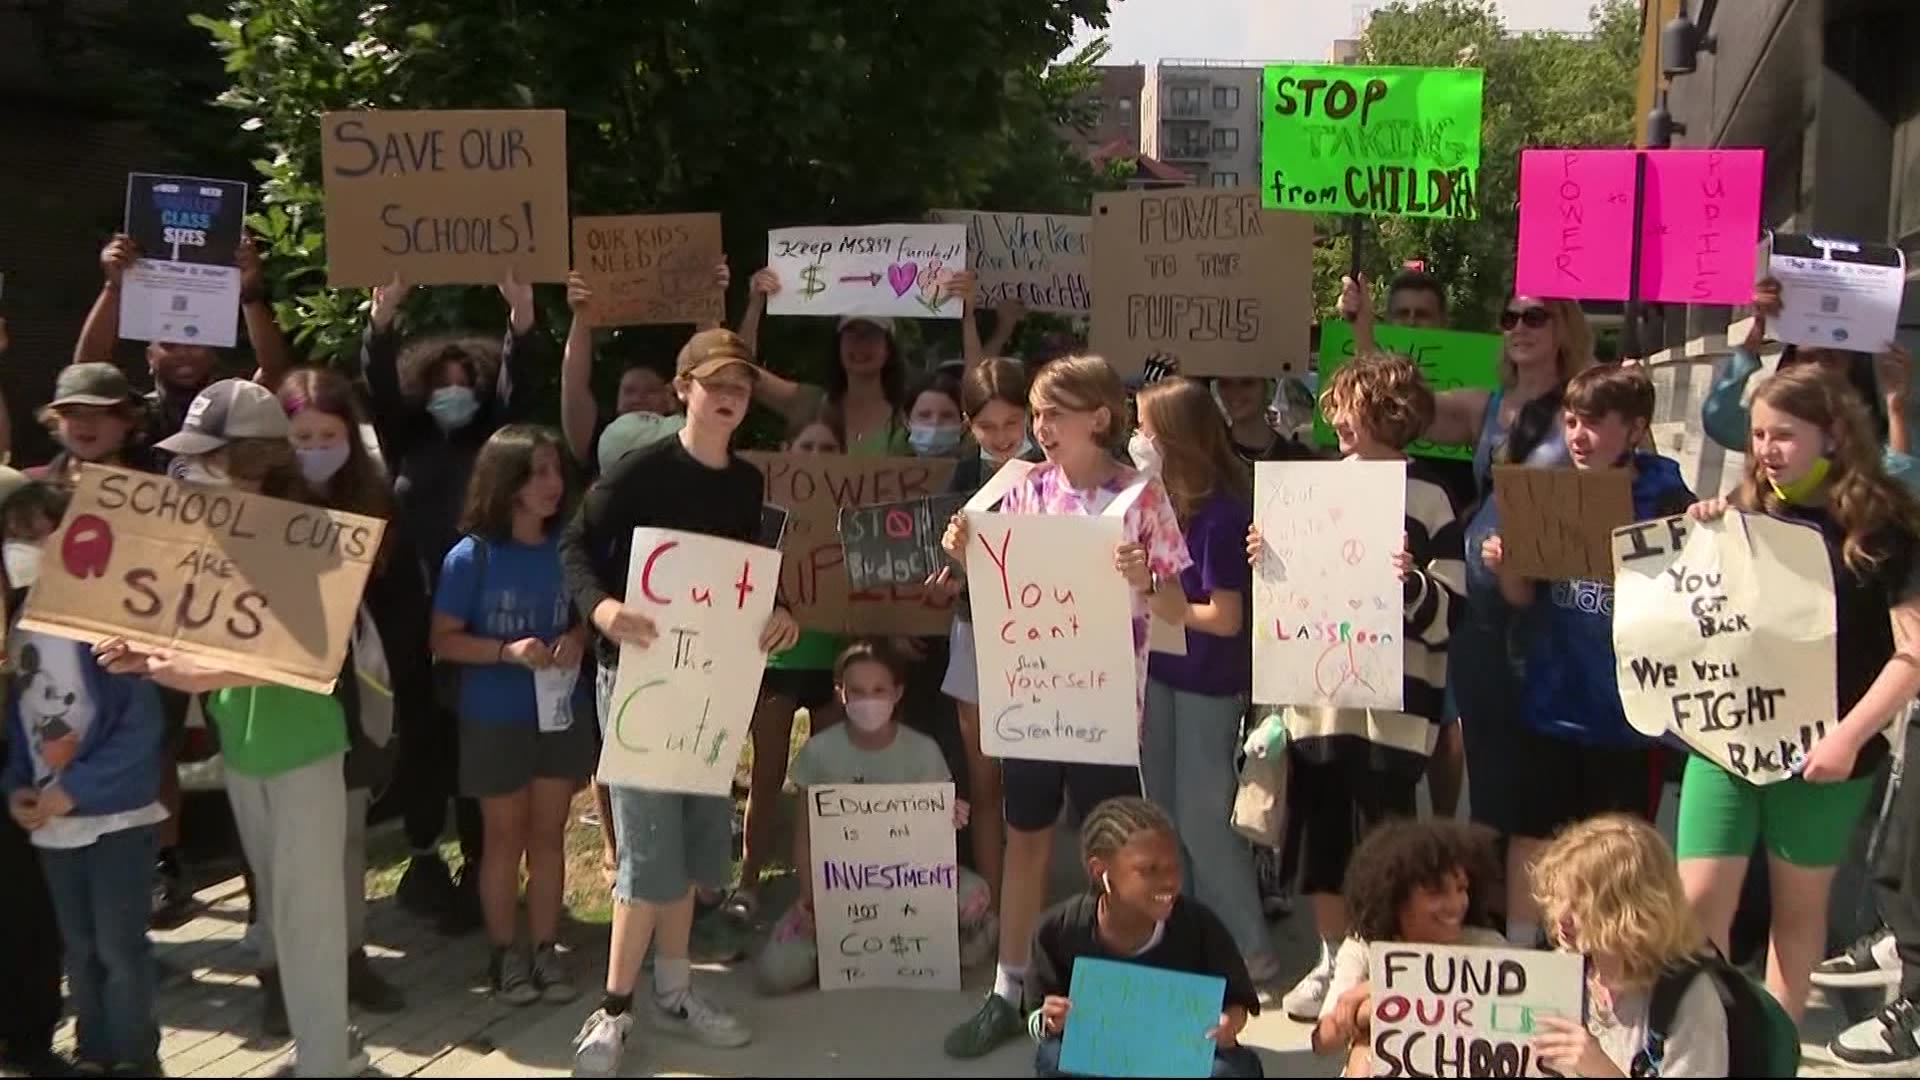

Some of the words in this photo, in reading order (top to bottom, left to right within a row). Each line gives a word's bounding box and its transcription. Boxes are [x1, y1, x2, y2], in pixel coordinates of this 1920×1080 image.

[1275, 76, 1388, 127] STOP
[334, 120, 446, 178] SAVE
[460, 128, 533, 171] OUR
[1303, 116, 1467, 167] TAKING
[1270, 170, 1338, 205] from
[161, 208, 211, 230] CLASS
[163, 226, 208, 247] SIZES
[380, 202, 536, 256] SCHOOLS!
[587, 228, 630, 251] OUR
[635, 224, 689, 250] KIDS
[1139, 194, 1264, 245] POWER
[1556, 153, 1583, 282] POWER
[1691, 152, 1726, 299] PUPILS
[774, 240, 833, 264] Keep
[1144, 253, 1178, 279] TO
[1196, 252, 1241, 279] THE
[1127, 293, 1261, 342] PUPILS
[767, 462, 929, 506] POWER
[97, 473, 256, 541] SCHOOL
[285, 513, 371, 558] CUTS
[1614, 517, 1688, 562] IF
[176, 549, 238, 579] ARE
[641, 541, 754, 610] Cut
[977, 527, 1075, 610] You
[1667, 565, 1722, 593] YOU
[122, 568, 270, 641] SUS
[1699, 614, 1751, 638] BACK
[670, 627, 713, 670] The
[1671, 686, 1786, 733] FIGHT
[823, 860, 955, 891] INVESTMENT
[1384, 951, 1527, 996] FUND
[1375, 994, 1474, 1027] OUR
